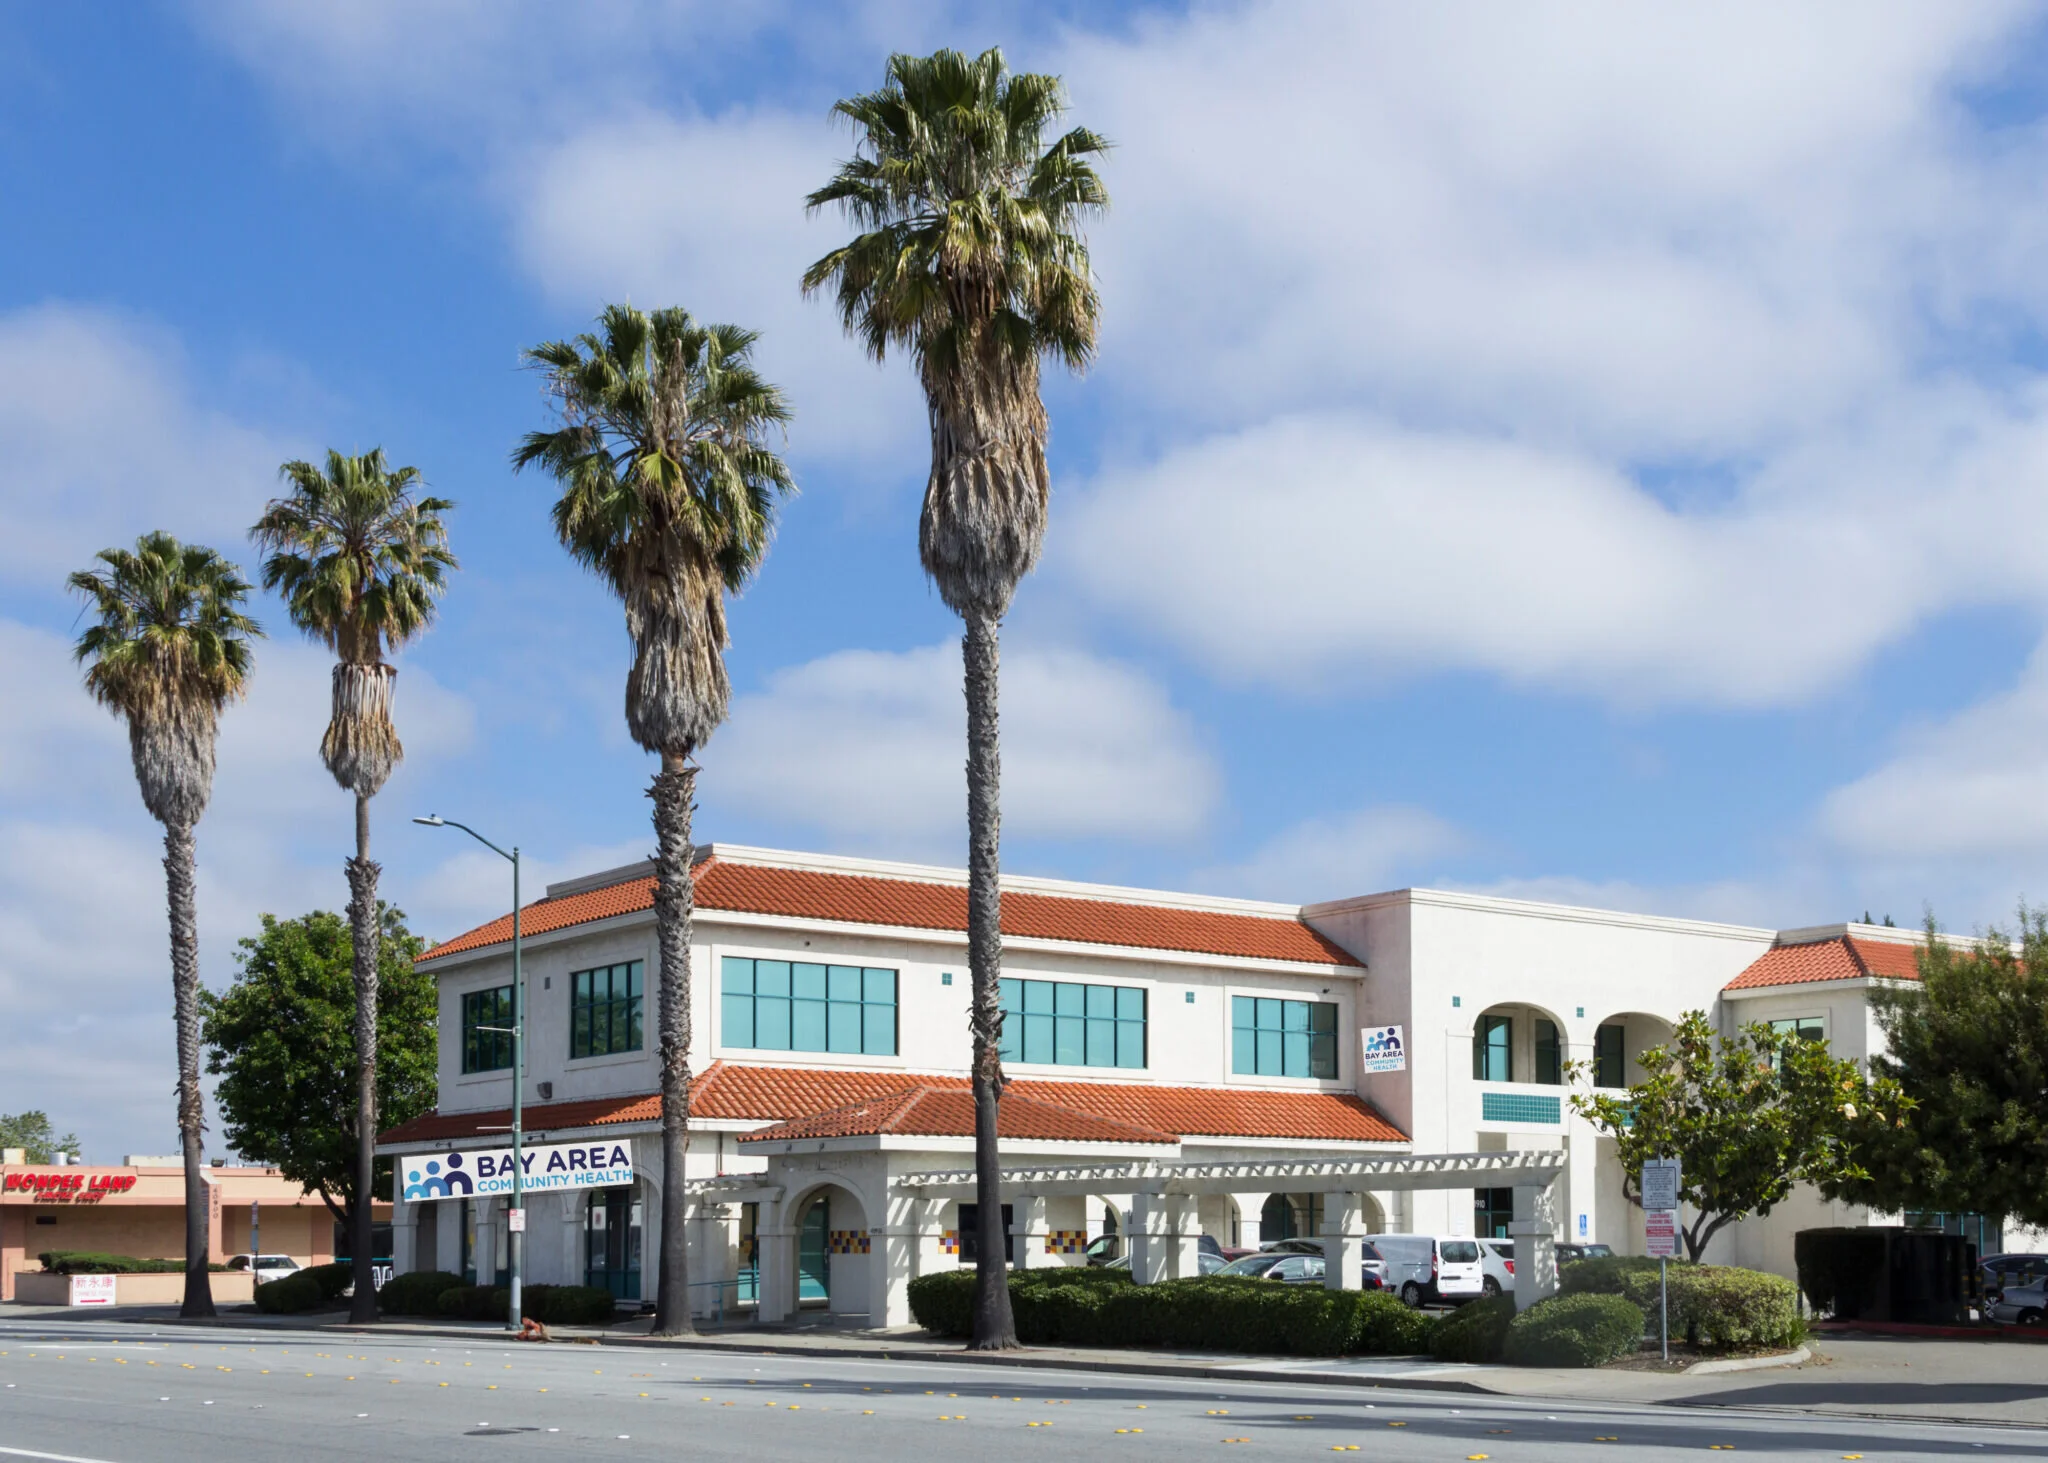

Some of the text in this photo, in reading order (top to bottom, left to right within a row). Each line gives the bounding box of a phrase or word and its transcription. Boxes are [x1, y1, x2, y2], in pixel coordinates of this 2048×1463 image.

[1366, 1057, 1404, 1066] COMMUNITY
[1382, 1050, 1403, 1058] AREA
[477, 1145, 630, 1178] BAY AREA
[4, 1173, 137, 1191] WONDER LAND
[477, 1169, 633, 1192] COMUNITY HEALTH
